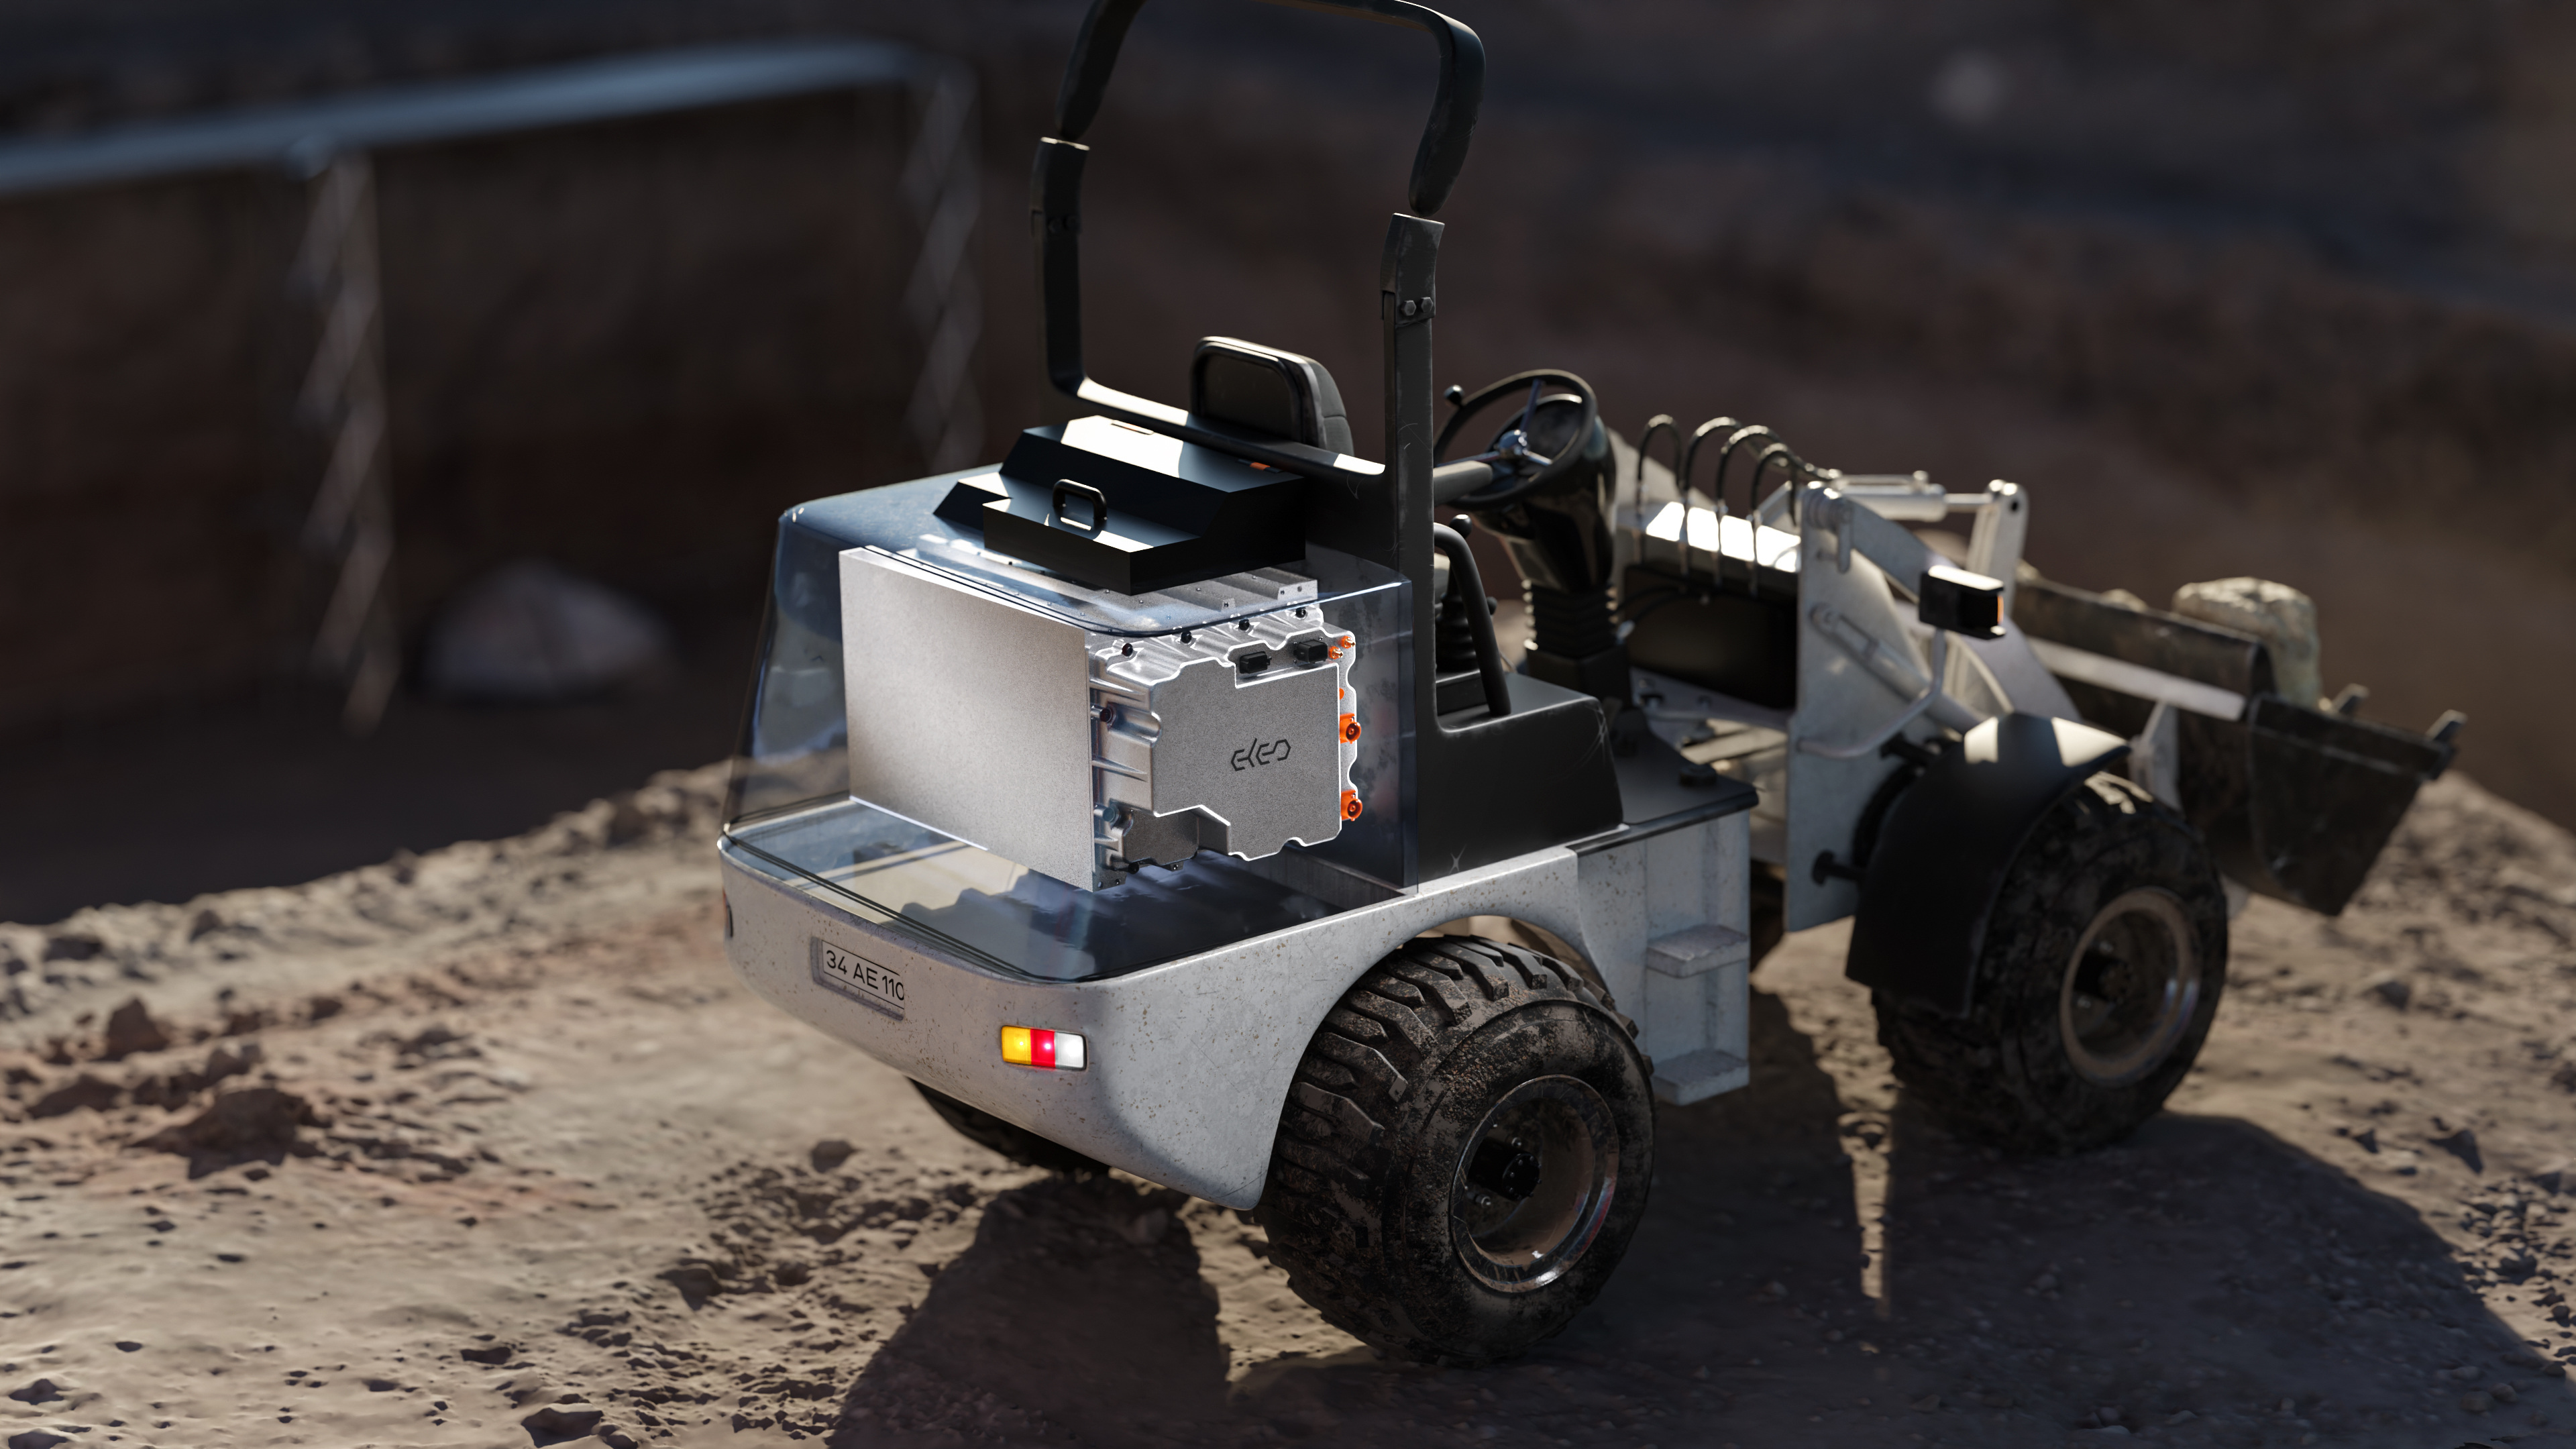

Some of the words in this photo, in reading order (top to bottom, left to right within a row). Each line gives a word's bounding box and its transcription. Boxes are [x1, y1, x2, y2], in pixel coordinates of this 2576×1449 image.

[826, 950, 847, 975] 34
[853, 963, 878, 989] AE
[882, 975, 904, 1001] 110
